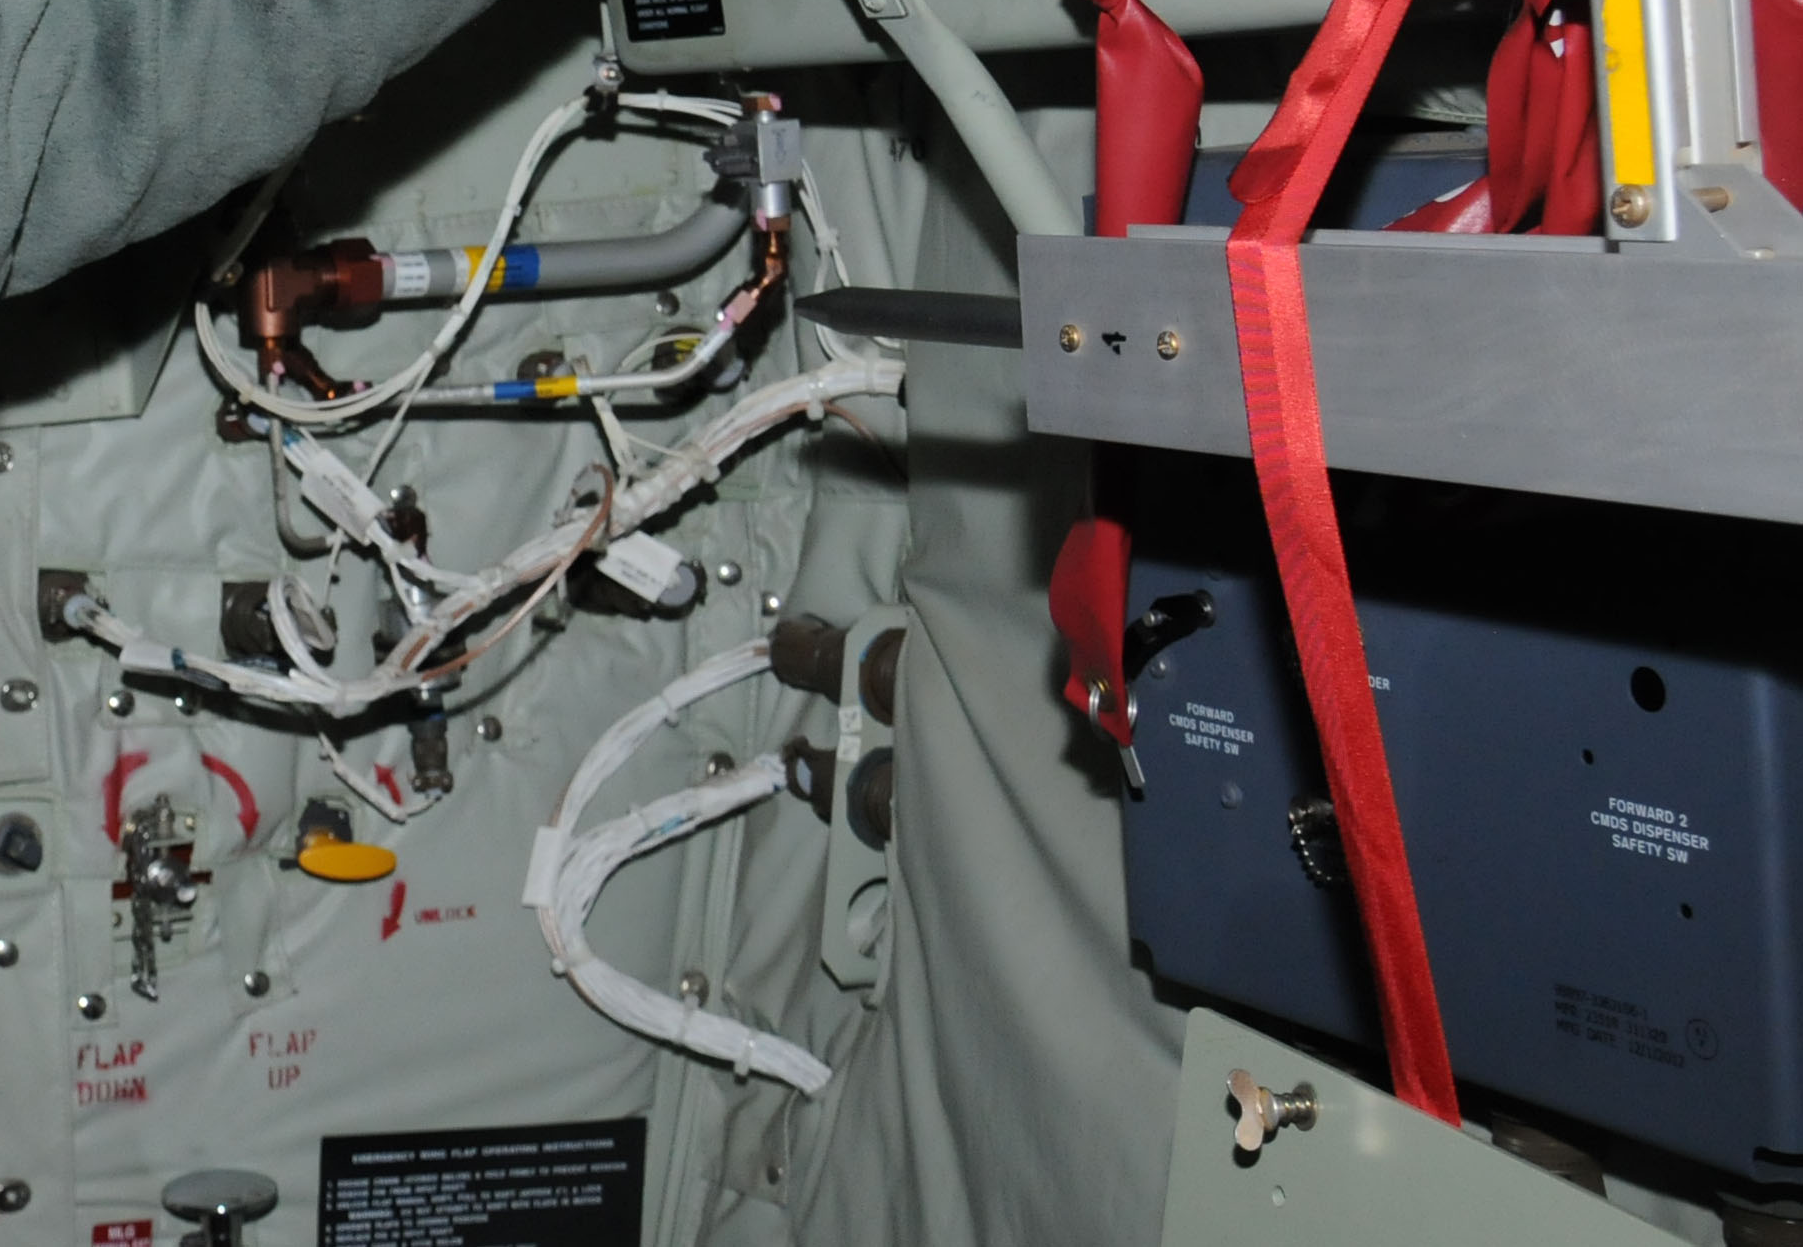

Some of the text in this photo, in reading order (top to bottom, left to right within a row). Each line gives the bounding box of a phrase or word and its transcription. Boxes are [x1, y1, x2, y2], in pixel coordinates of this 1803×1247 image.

[1186, 701, 1234, 723] FORWARD
[1169, 713, 1254, 744] CMDS DISPENSER
[1184, 732, 1239, 756] SAFETY SW
[1608, 797, 1689, 827] FORWARD 2
[1590, 811, 1709, 851] CMDS DISPENSER
[1612, 834, 1688, 864] SAFETY SW
[77, 1040, 144, 1071] FLAP
[249, 1029, 317, 1057] FLAP
[76, 1075, 148, 1105] DOWN
[268, 1065, 300, 1090] UP
